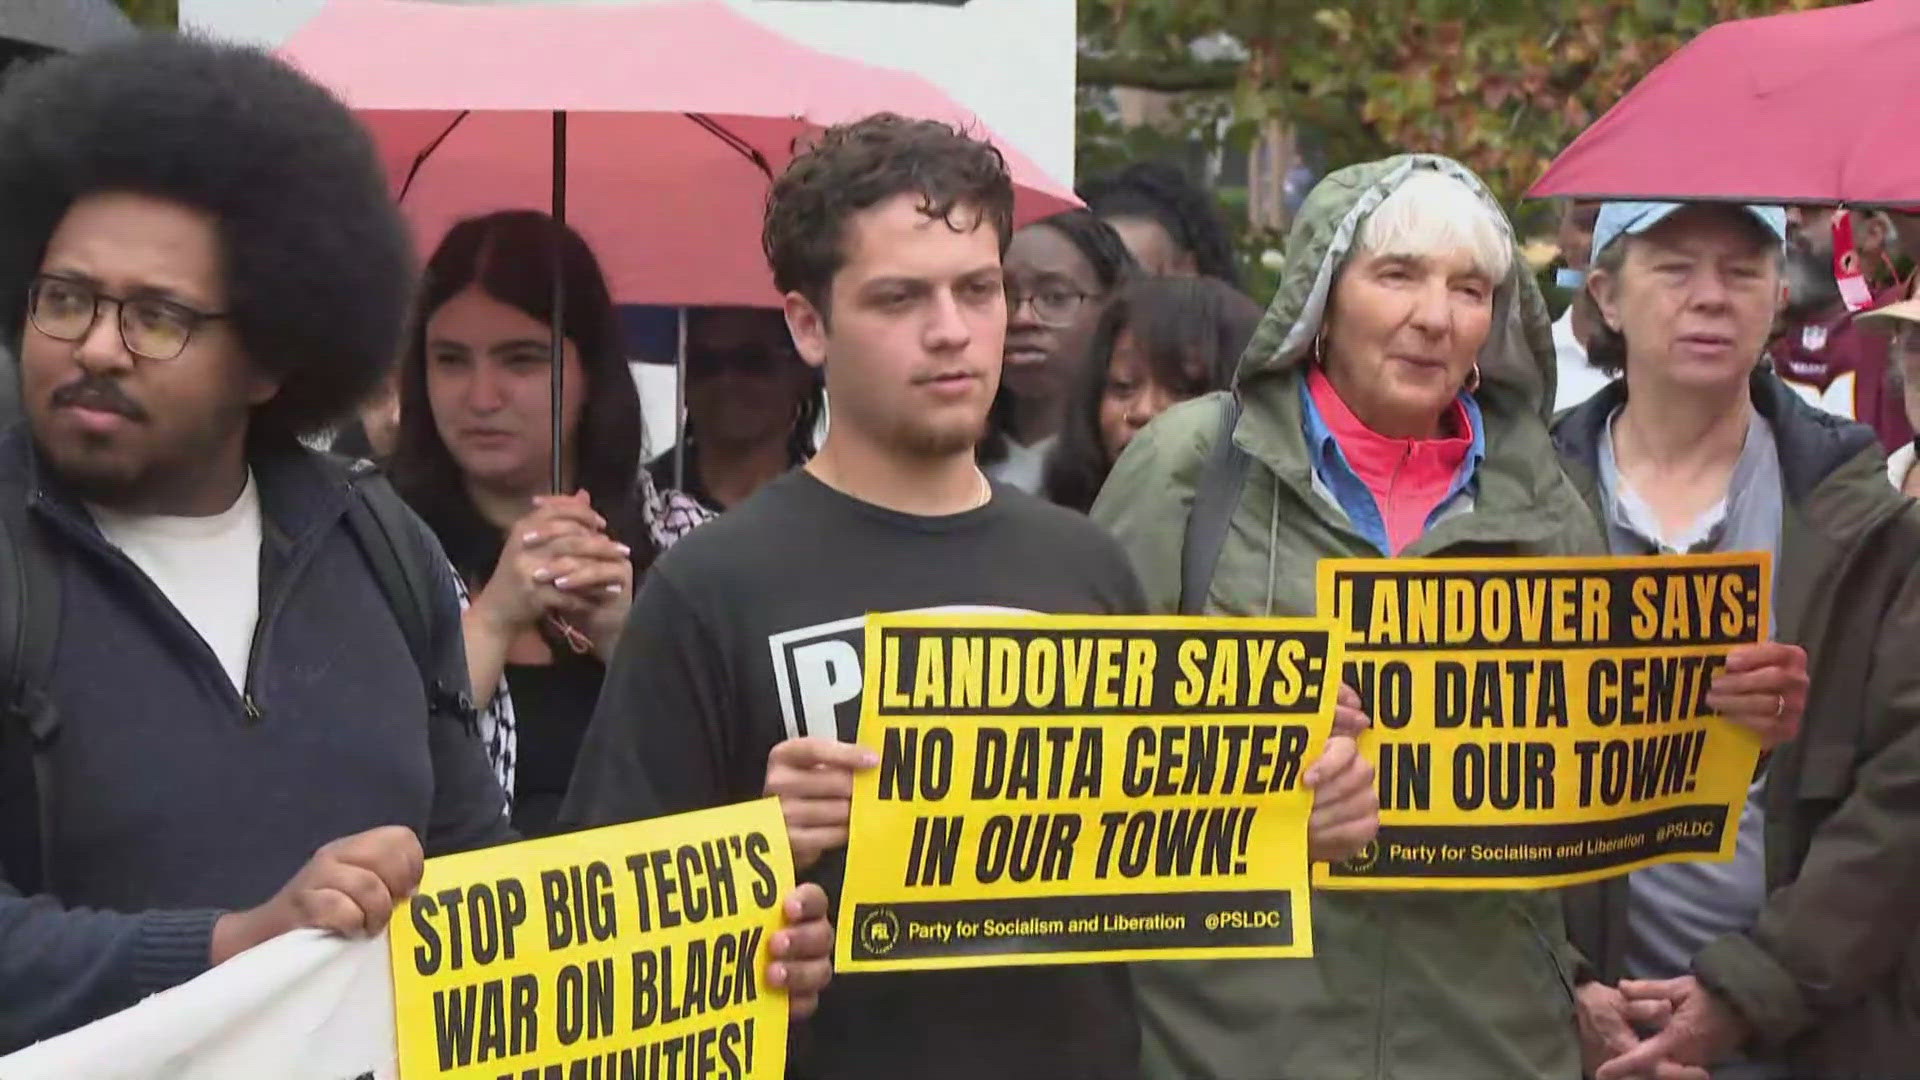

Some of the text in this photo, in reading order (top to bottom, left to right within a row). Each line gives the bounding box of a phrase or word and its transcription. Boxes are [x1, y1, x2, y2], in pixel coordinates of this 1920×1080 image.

[1338, 572, 1757, 645] LANDOVER SAYS:
[883, 637, 1321, 708] LANDOVER SAYS:
[1342, 655, 1727, 729] NO DATA CENTE
[879, 725, 1308, 800] NO DATA CENTER
[1379, 729, 1705, 811] IN OUR TOWN!
[905, 808, 1257, 886] IN OUR TOWN!
[1390, 844, 1436, 864] Party
[1441, 844, 1467, 861] for
[1471, 843, 1552, 860] Socialism
[1556, 839, 1584, 858] and
[1587, 832, 1646, 855] Liberation
[410, 877, 527, 976] STOP
[541, 861, 618, 951] BIG
[626, 832, 778, 933] TECH'S
[909, 911, 1281, 942] Party for Socialism and Liberation @PSLDC
[434, 973, 539, 1071] WAR
[556, 958, 615, 1045] ON
[632, 926, 764, 1030] BLACK
